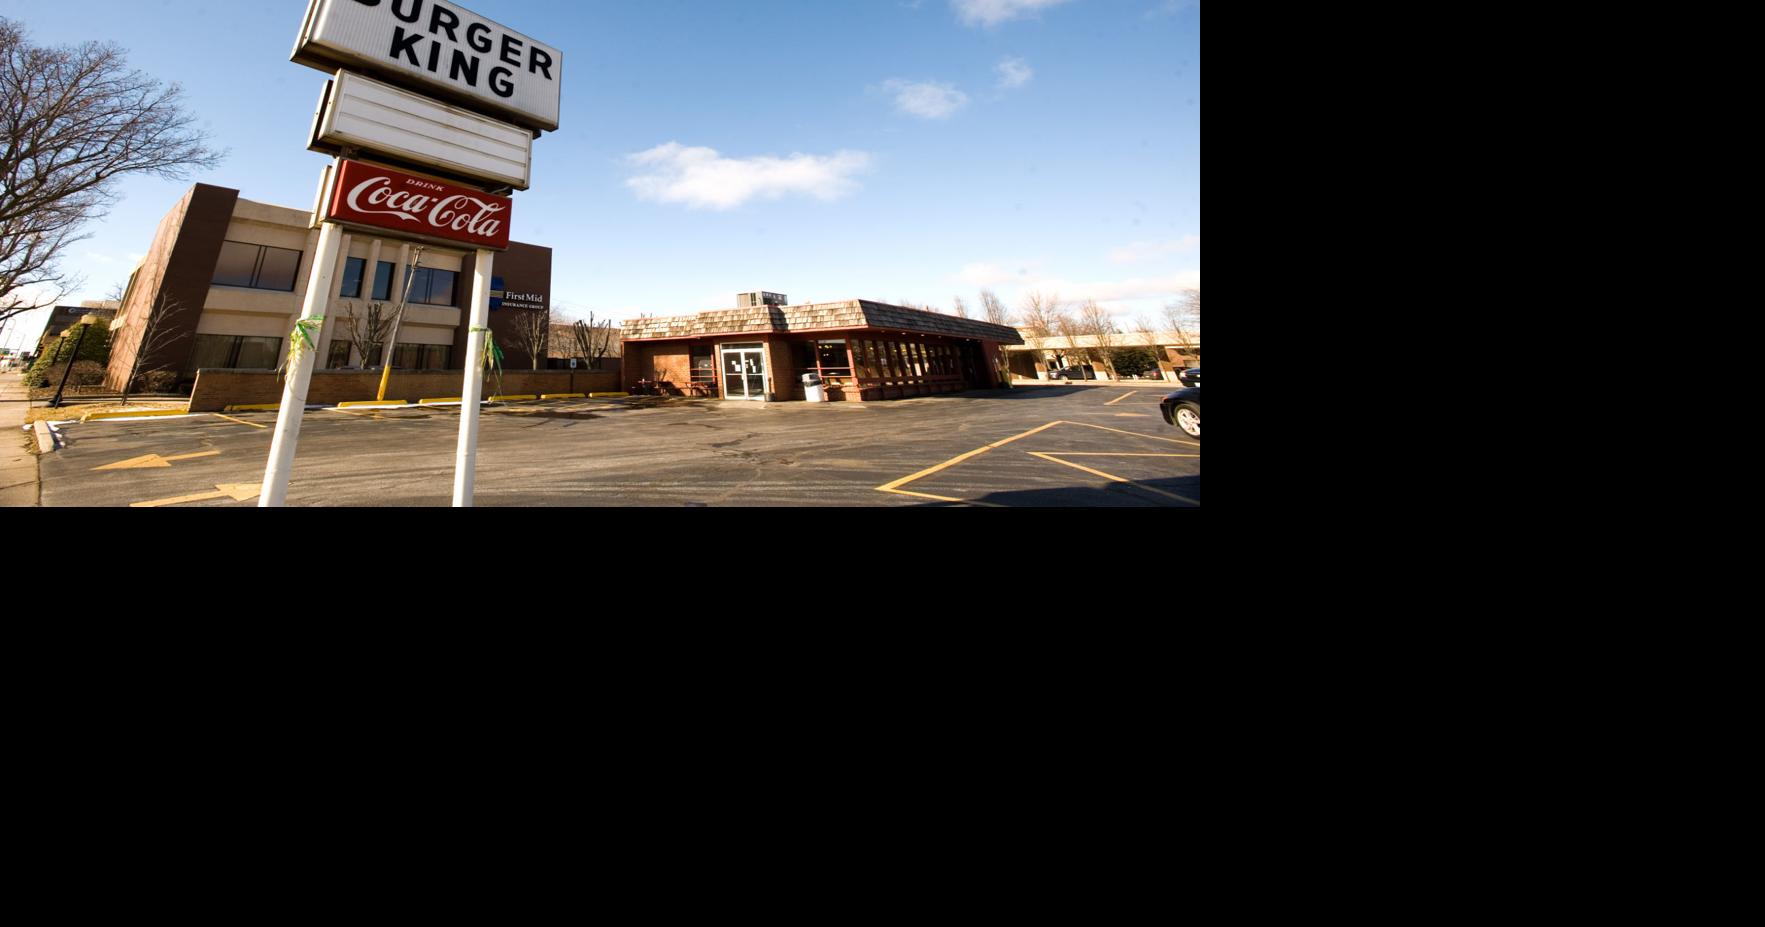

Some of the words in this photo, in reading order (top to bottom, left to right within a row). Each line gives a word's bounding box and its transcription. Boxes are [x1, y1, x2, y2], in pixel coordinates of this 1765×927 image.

[352, 0, 553, 80] URGER
[389, 26, 515, 98] KING
[347, 176, 506, 237] Coca-Cola
[405, 178, 445, 191] DRINK
[506, 292, 525, 301] First
[525, 293, 543, 303] Mid
